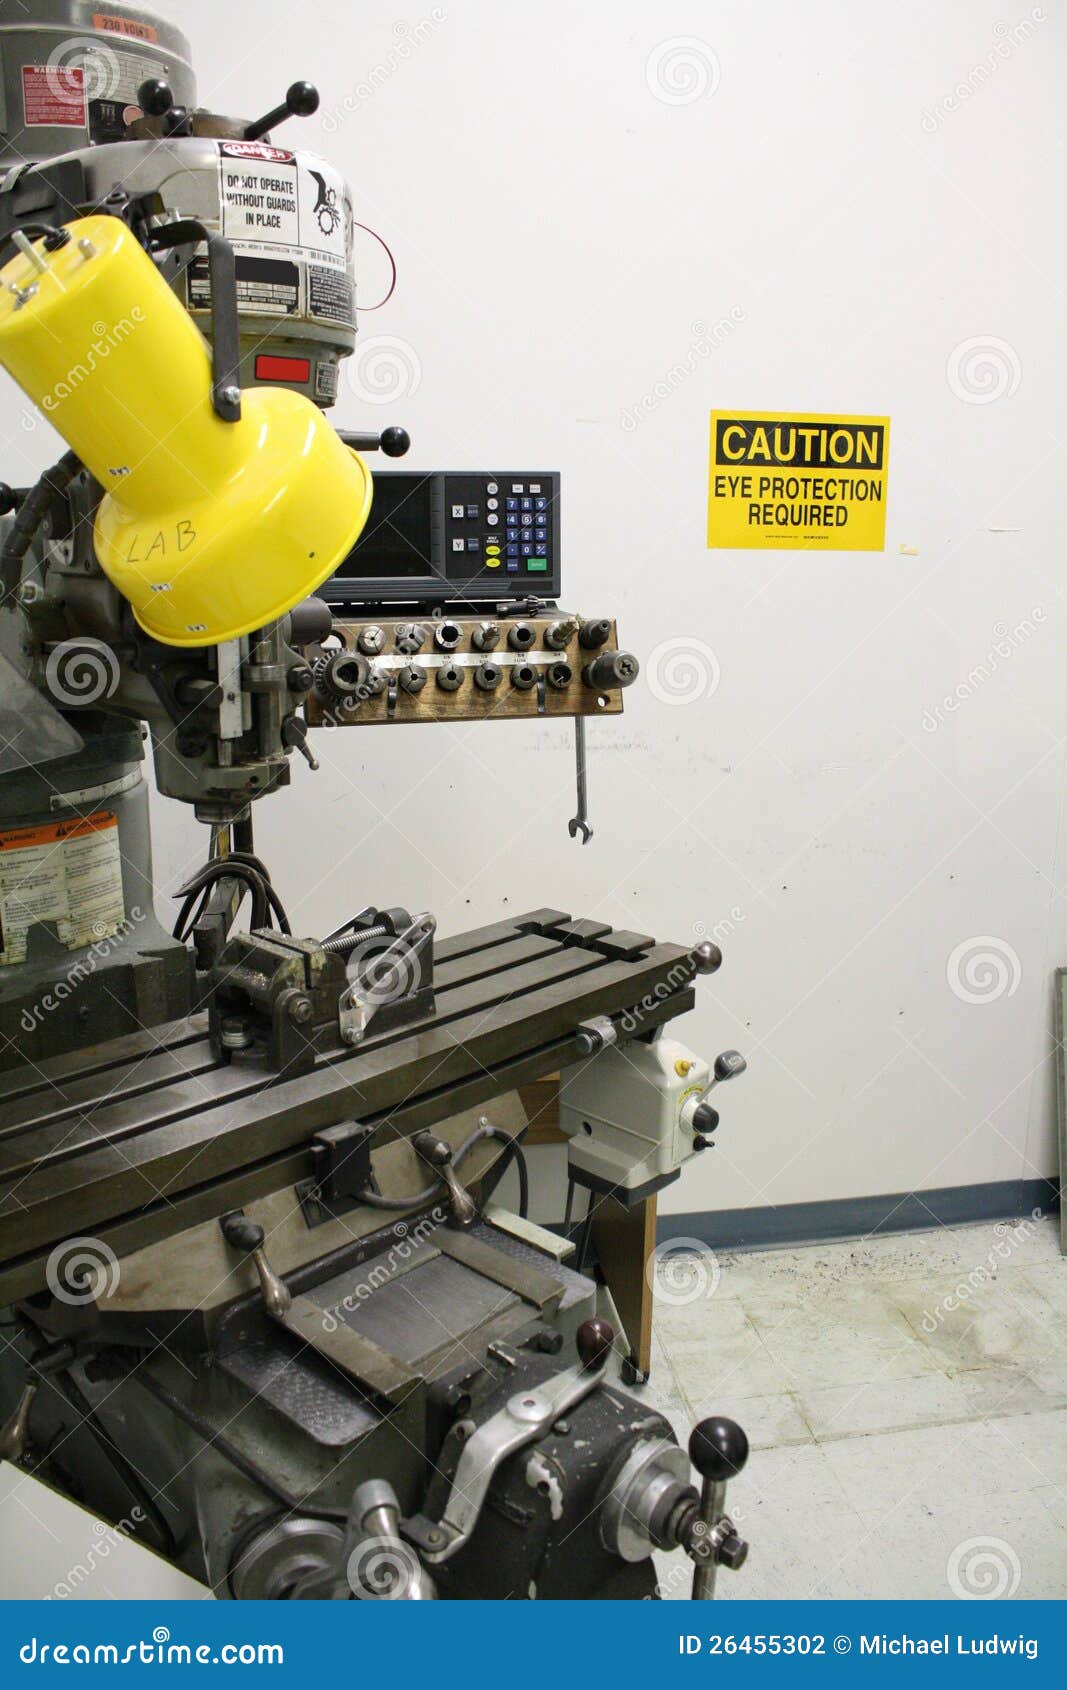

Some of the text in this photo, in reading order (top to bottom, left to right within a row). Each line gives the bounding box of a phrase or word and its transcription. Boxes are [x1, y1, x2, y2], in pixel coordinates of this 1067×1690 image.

[103, 18, 120, 31] 230
[227, 175, 239, 187] DO
[260, 178, 294, 194] OPERATE
[226, 193, 296, 213] WITHOUT GUARDS
[245, 213, 281, 228] IN PLACE
[722, 425, 878, 464] CAUTION
[714, 475, 882, 501] EYE PROTECTION
[749, 503, 848, 526] REQUIRED
[127, 520, 196, 563] LAB
